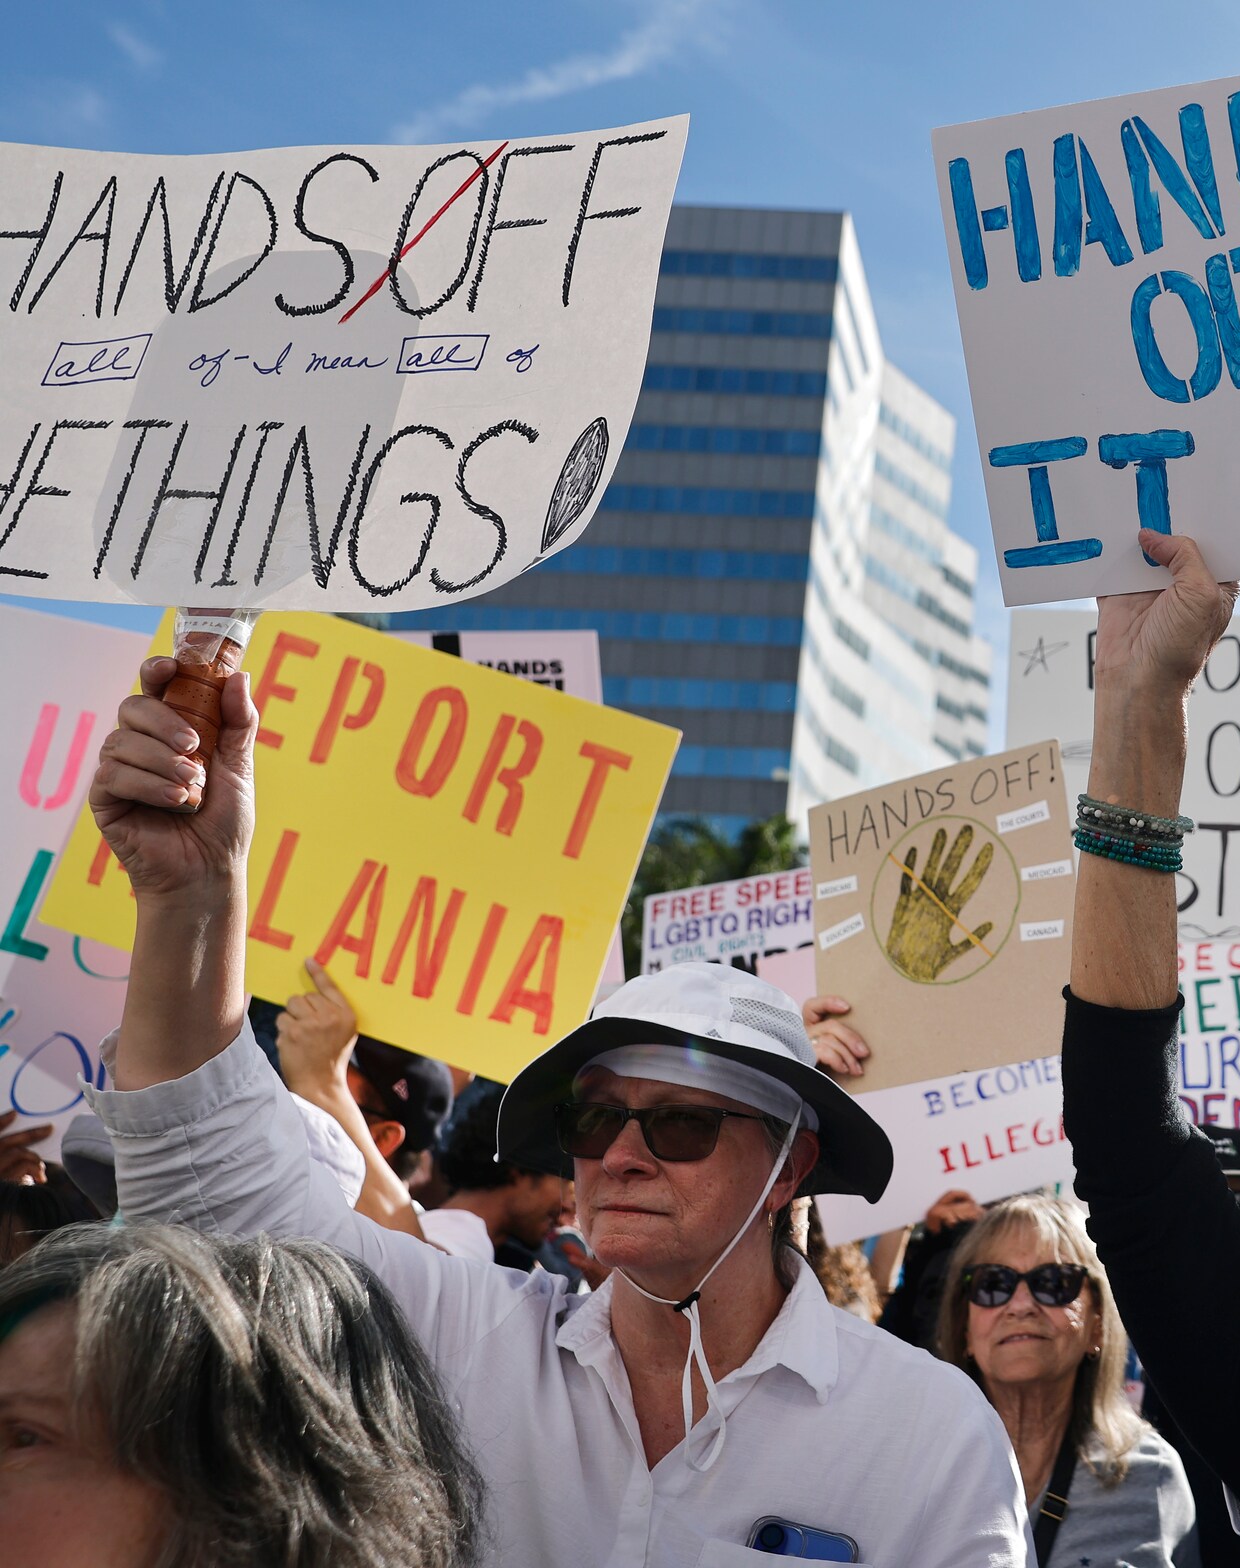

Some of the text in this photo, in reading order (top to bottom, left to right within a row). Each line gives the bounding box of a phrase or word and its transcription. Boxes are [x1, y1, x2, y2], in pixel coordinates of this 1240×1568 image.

[0, 131, 667, 318] HANDS OFF
[55, 347, 133, 378] all
[306, 353, 388, 373] mean
[407, 343, 475, 367] all
[506, 343, 537, 373] of
[989, 429, 1195, 568] IT
[256, 630, 633, 860] EPORT
[828, 747, 1056, 863] HANDS OFF!
[1016, 810, 1045, 826] COURTS
[652, 871, 811, 922] FREE SPEE
[1027, 866, 1065, 880] MEDICAID
[87, 830, 564, 1035] LANIA
[651, 898, 812, 949] LGBTQ RIGH
[1026, 926, 1058, 938] CANADA
[924, 1056, 1062, 1117] BECOME
